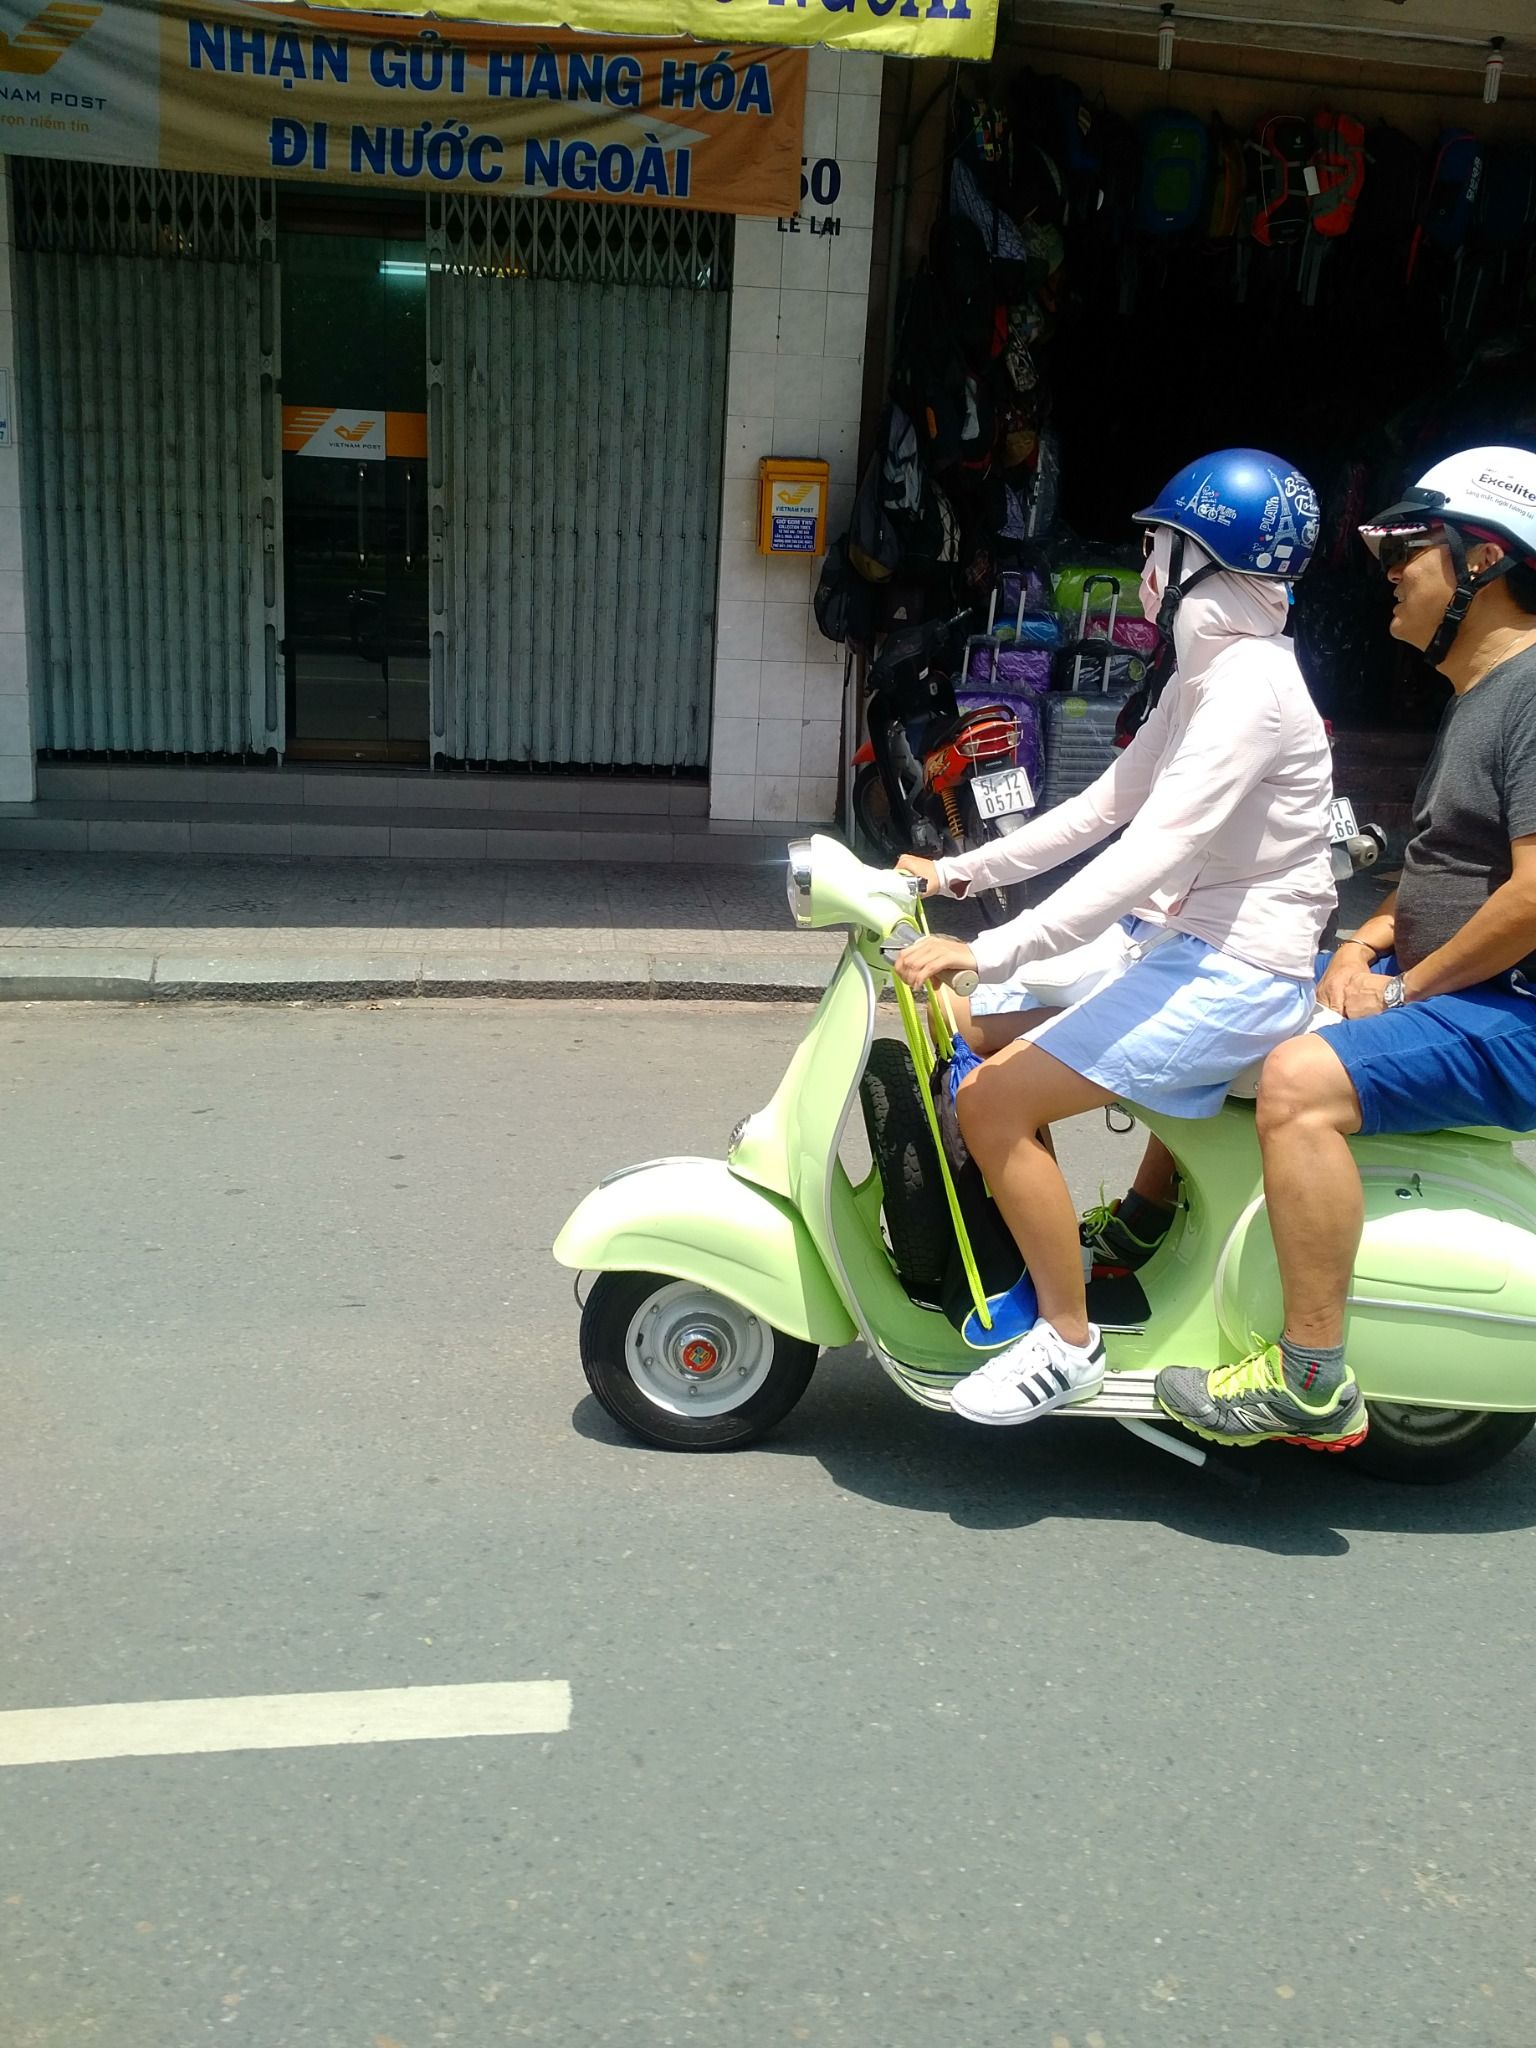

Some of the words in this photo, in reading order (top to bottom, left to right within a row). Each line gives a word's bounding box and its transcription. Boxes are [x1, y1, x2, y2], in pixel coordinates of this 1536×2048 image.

[188, 18, 349, 89] NHẬN
[369, 30, 466, 93] GỬI
[488, 43, 642, 107] HÀNG
[660, 51, 774, 114] HÓA
[50, 91, 108, 111] POST
[71, 120, 90, 132] tin
[268, 117, 328, 170] ĐI
[350, 119, 504, 184] NƯỚC
[523, 133, 691, 198] NGOÀI
[810, 215, 842, 236] LAI
[328, 441, 361, 449] VIETNAM
[1478, 472, 1536, 503] Excelite
[985, 790, 1024, 814] 0571
